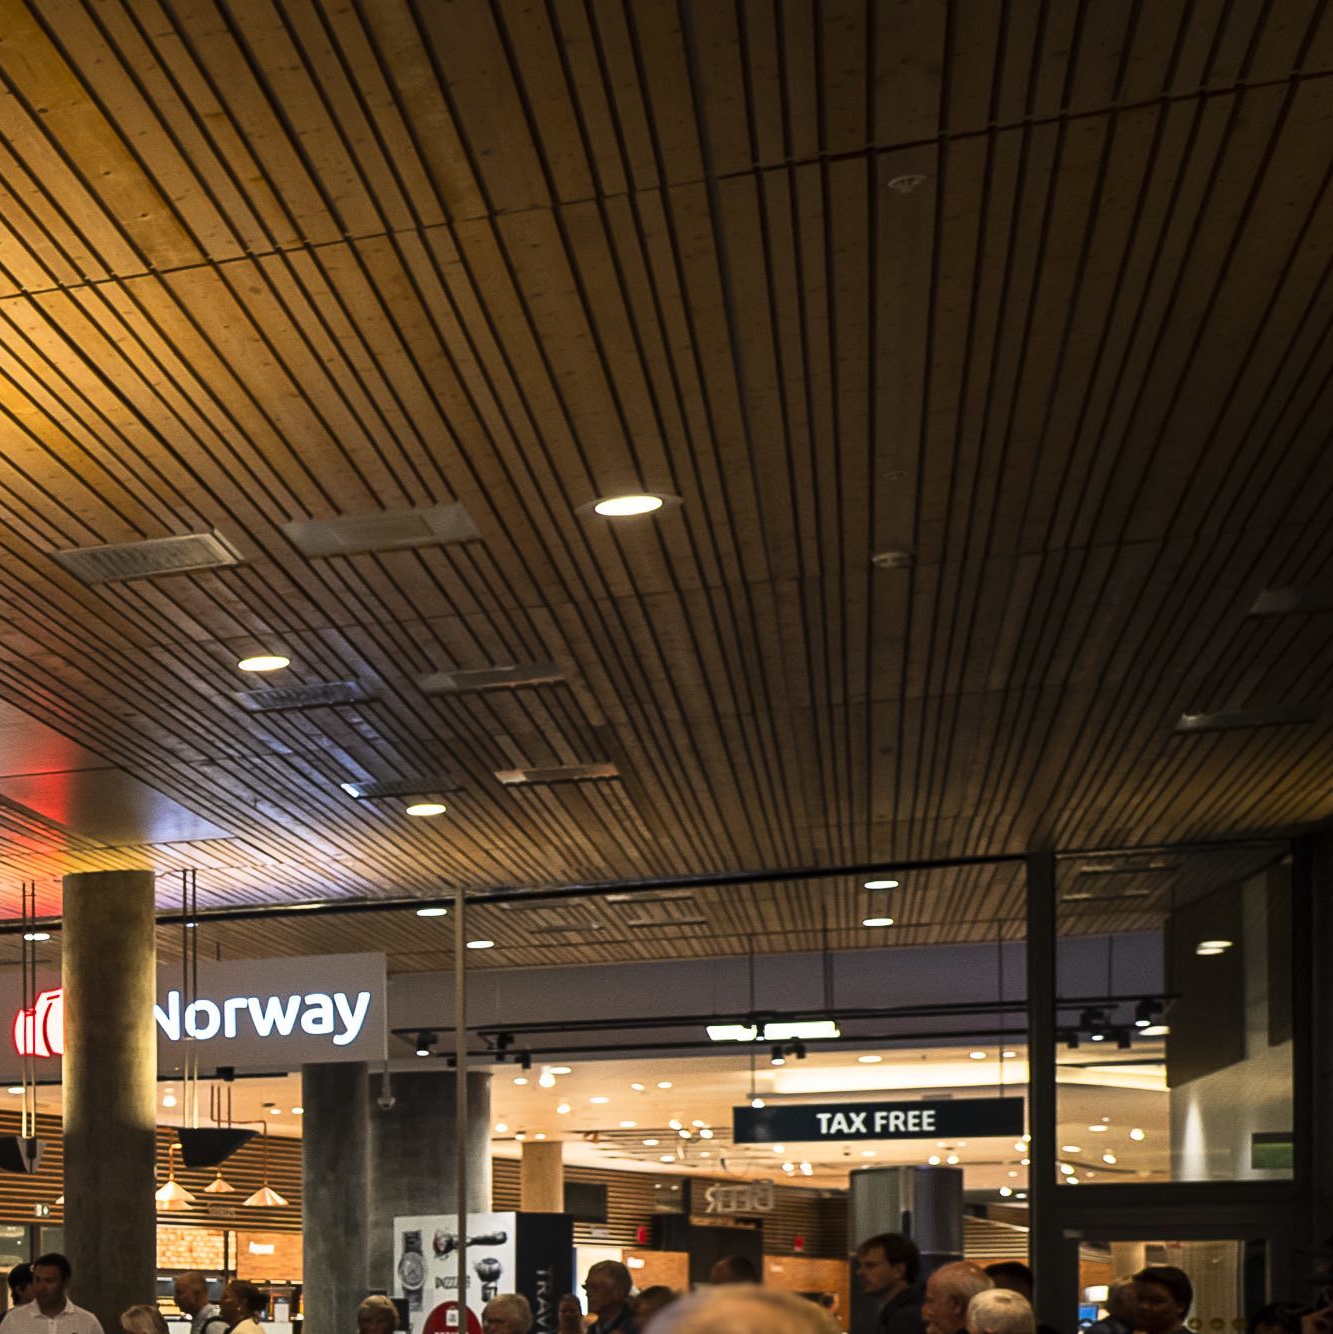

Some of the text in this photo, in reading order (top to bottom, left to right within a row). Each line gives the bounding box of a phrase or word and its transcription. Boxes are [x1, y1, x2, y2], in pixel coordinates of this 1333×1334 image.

[153, 990, 371, 1046] Norway
[816, 1110, 937, 1134] TAX FREE
